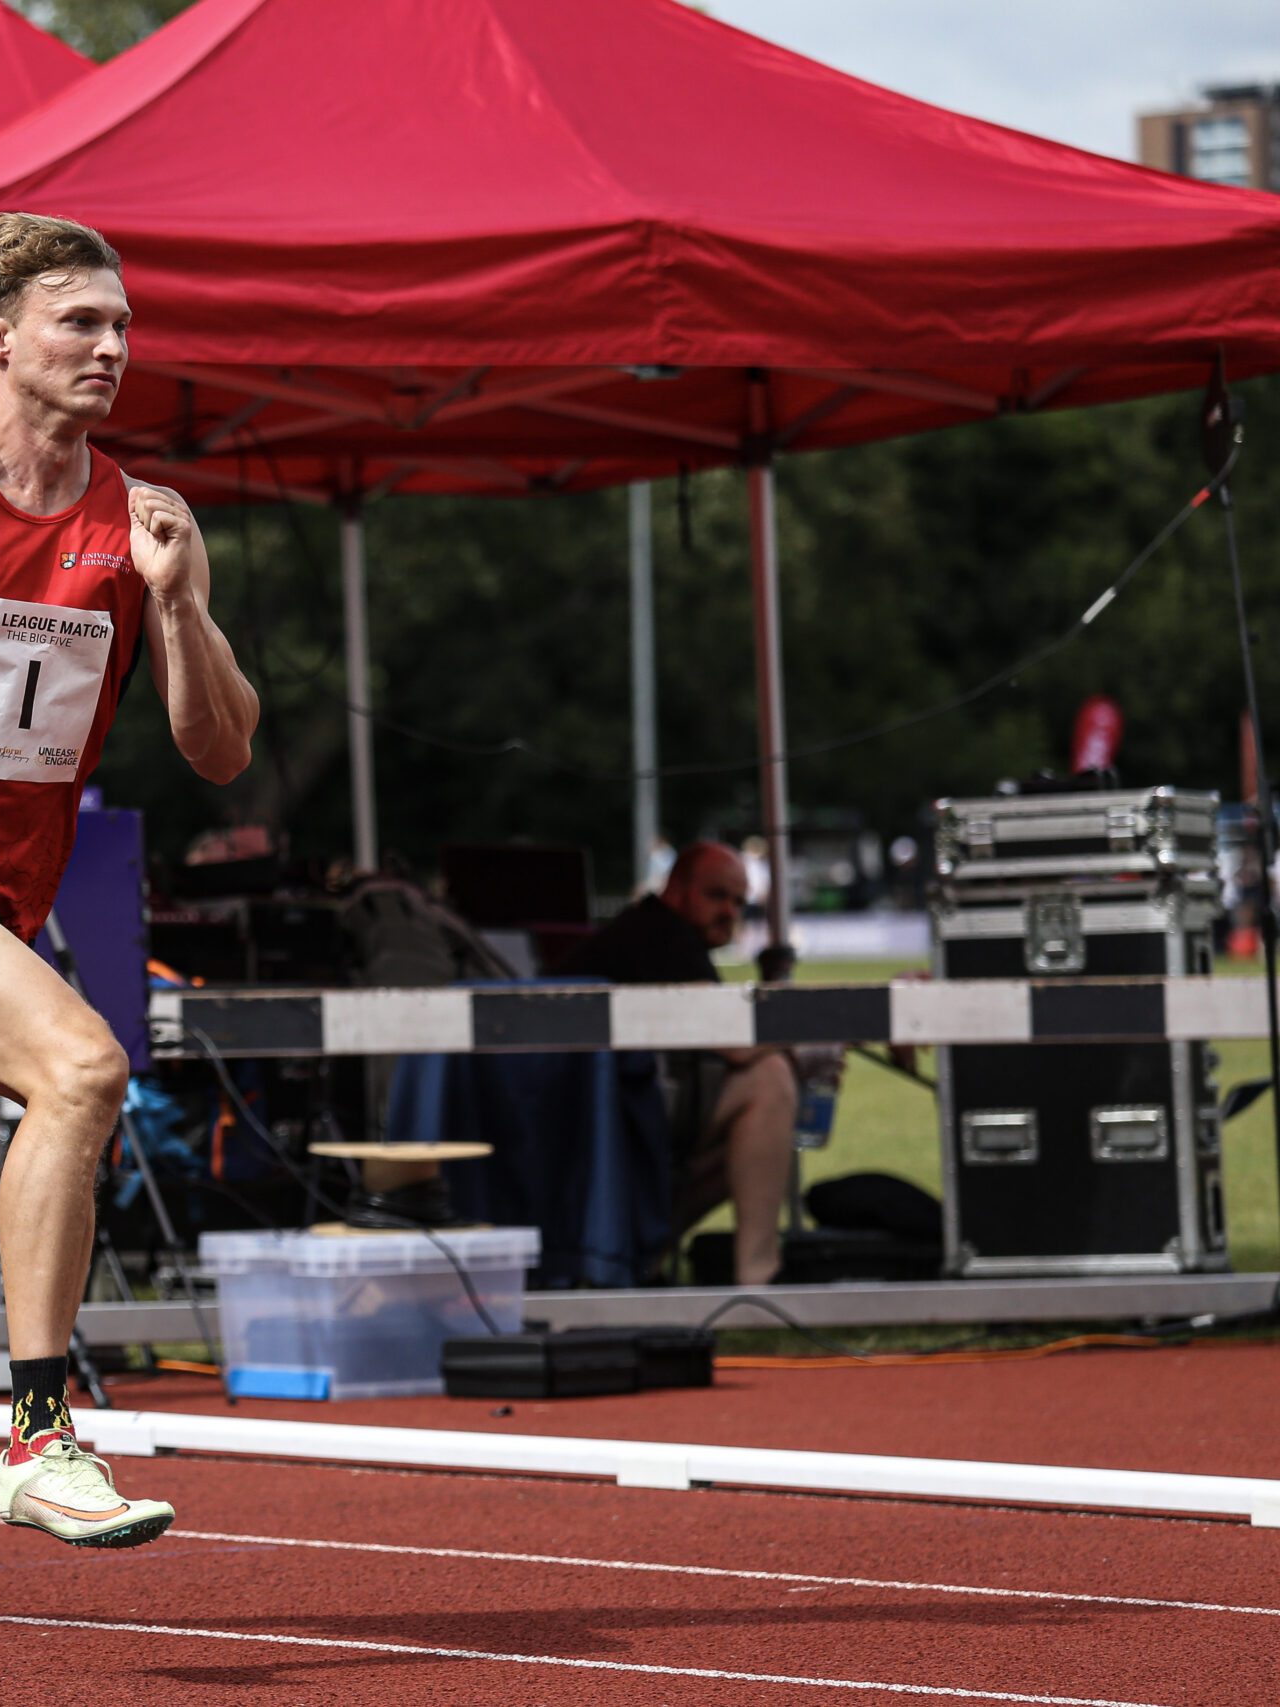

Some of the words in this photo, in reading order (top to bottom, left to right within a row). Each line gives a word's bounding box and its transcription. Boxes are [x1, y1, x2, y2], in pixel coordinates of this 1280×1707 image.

[2, 612, 58, 633] LEAGUE
[60, 620, 108, 639] MATCH
[7, 630, 27, 642] THE
[29, 632, 47, 643] BIG
[49, 635, 73, 648] FIVE
[44, 756, 78, 766] ENGAGE
